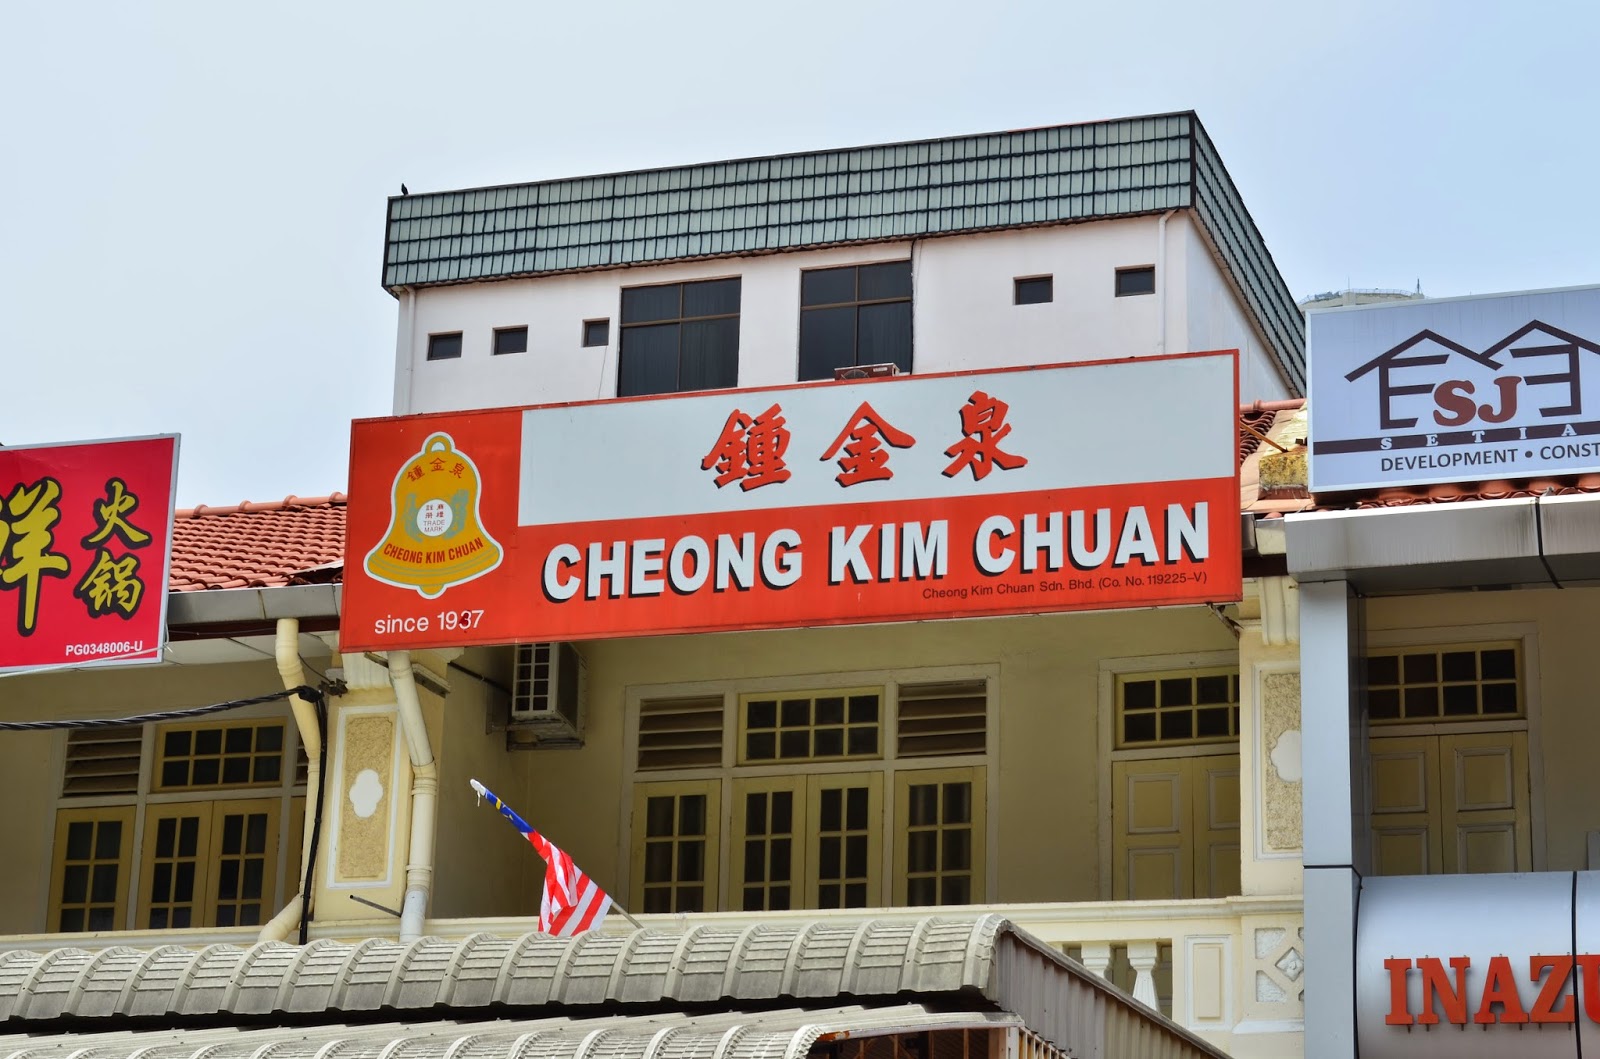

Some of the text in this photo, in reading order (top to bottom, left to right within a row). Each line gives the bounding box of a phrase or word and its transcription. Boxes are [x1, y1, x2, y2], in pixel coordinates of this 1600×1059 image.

[1433, 375, 1522, 427] SJ
[1381, 448, 1519, 472] DEVELOPMENT
[383, 537, 484, 564] CHEONG KIM CHUAN
[542, 501, 1209, 604] CHEONG KIM CHUAN
[922, 588, 968, 599] Cheong
[971, 585, 993, 596] Kim
[996, 583, 1035, 595] Chuan
[1039, 581, 1065, 592] Sdn.
[1069, 578, 1095, 590] Bhd.
[1098, 577, 1121, 590] (Co.
[1125, 576, 1144, 587] No.
[374, 609, 484, 634] since 1937
[65, 640, 143, 656] PG0348006-U
